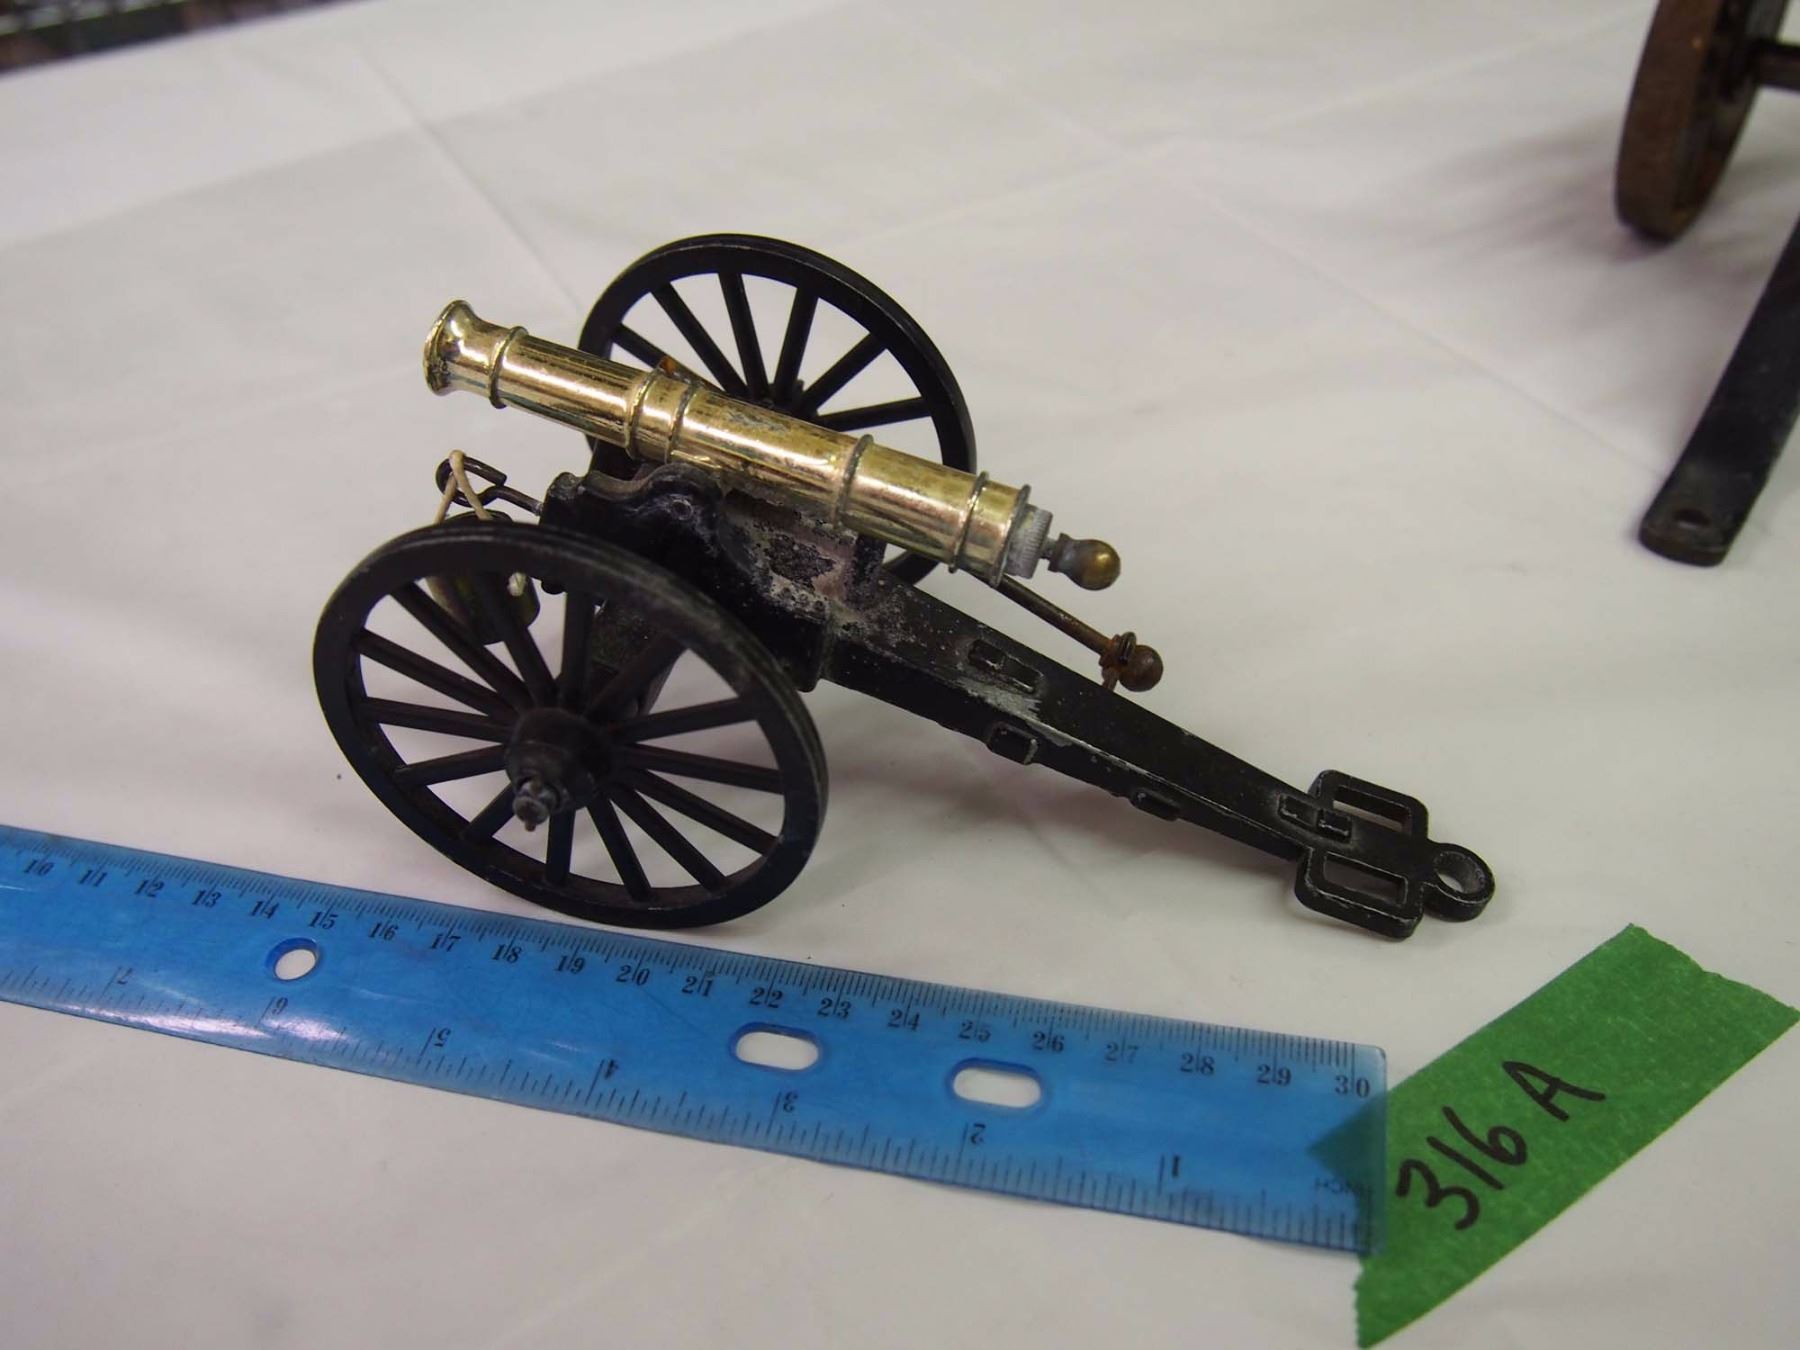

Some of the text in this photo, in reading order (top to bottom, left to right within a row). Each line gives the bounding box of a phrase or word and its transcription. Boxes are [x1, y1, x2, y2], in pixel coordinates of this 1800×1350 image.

[22, 858, 1371, 1098] 10 11 12 13 14 15 16 17 18 19 20 21 22 23 24 25 26 27 28 29 30
[116, 967, 1182, 1179] 1 2 3 4 5 6 7
[1396, 1060, 1606, 1230] 316 A
